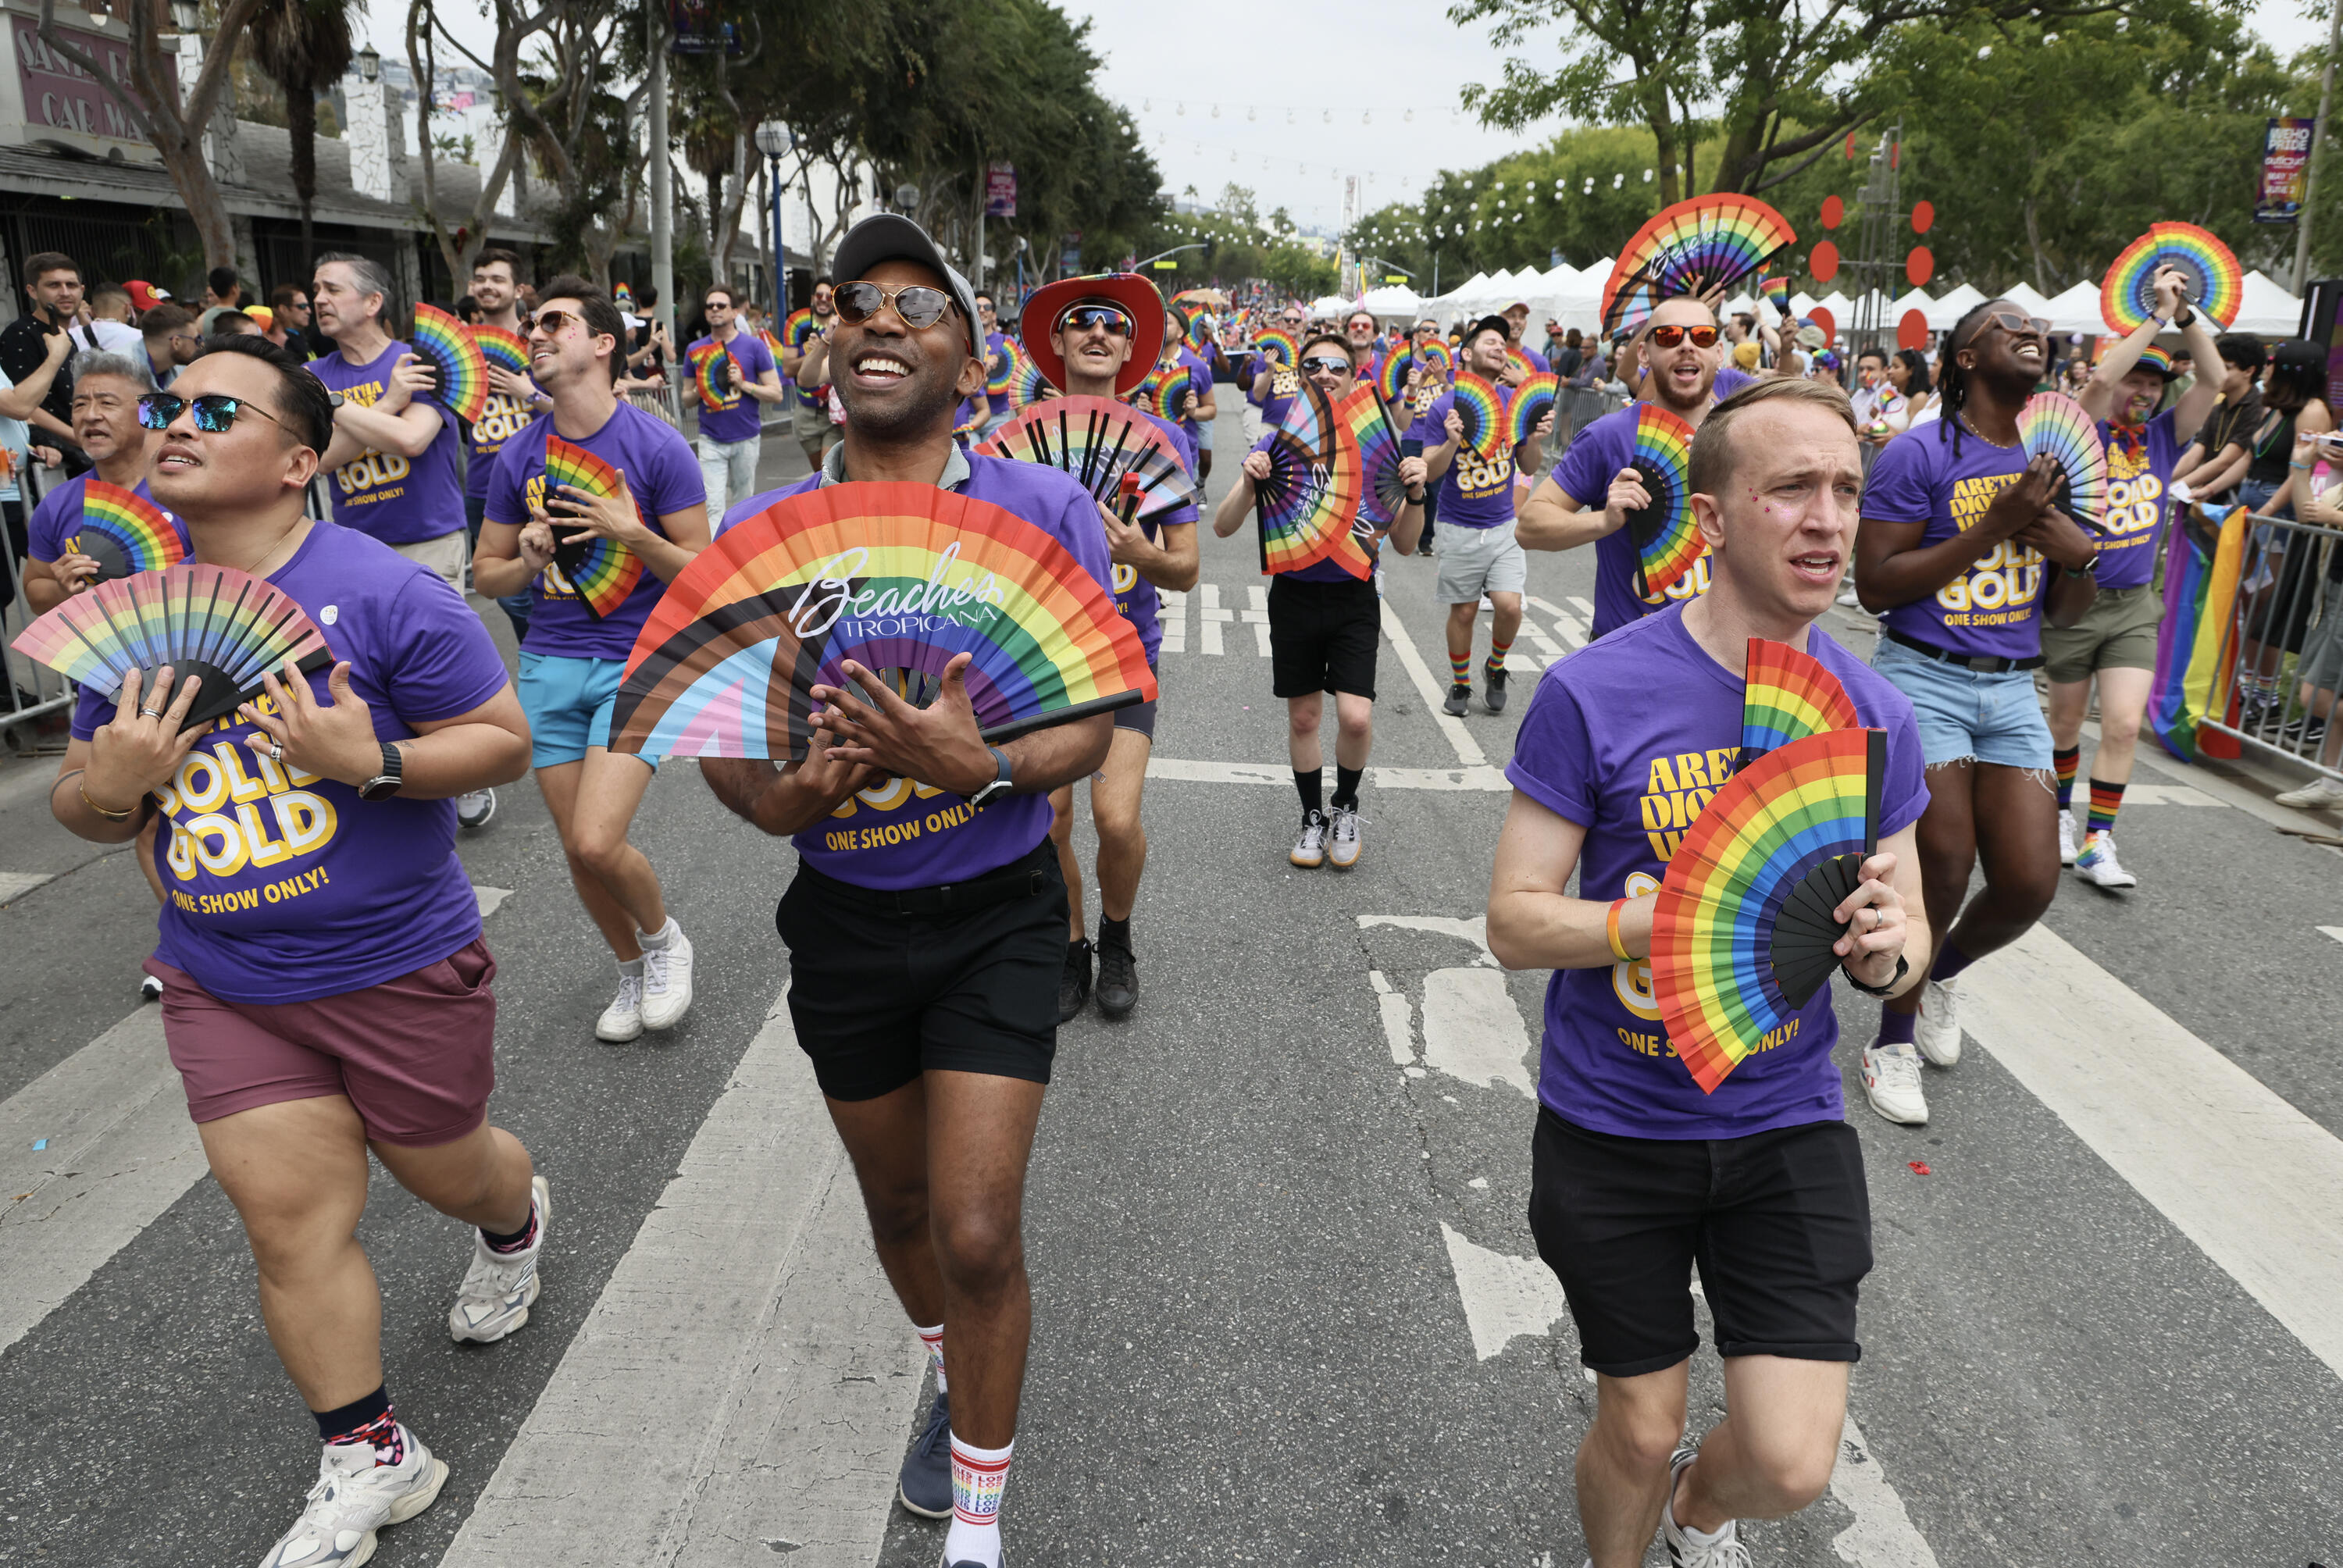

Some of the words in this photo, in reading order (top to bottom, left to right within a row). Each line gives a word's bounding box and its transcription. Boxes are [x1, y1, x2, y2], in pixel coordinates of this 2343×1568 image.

[41, 91, 95, 133] CAR
[2268, 139, 2308, 151] PRIDE
[2270, 127, 2310, 140] WEHO
[335, 454, 410, 494] GOLD
[1457, 459, 1510, 491] GOLD
[353, 494, 377, 506] SHOW
[378, 487, 404, 501] ONLY!
[1949, 493, 1997, 517] DIO
[2102, 501, 2159, 535] OLD
[788, 541, 1004, 639] Beaches
[1936, 565, 2042, 611] GOLD
[840, 606, 997, 637] TROPICANA
[1944, 614, 1970, 625] ONE
[1972, 611, 2008, 625] SHOW
[1640, 786, 1724, 830] DIO
[166, 790, 337, 881] GOLD
[826, 830, 858, 851] ONE
[861, 819, 921, 850] SHOW
[925, 802, 984, 832] ONLY
[172, 889, 198, 912] ONE
[198, 888, 259, 914] SHOW
[263, 866, 330, 903] ONLY!
[1617, 1027, 1659, 1056] ONE
